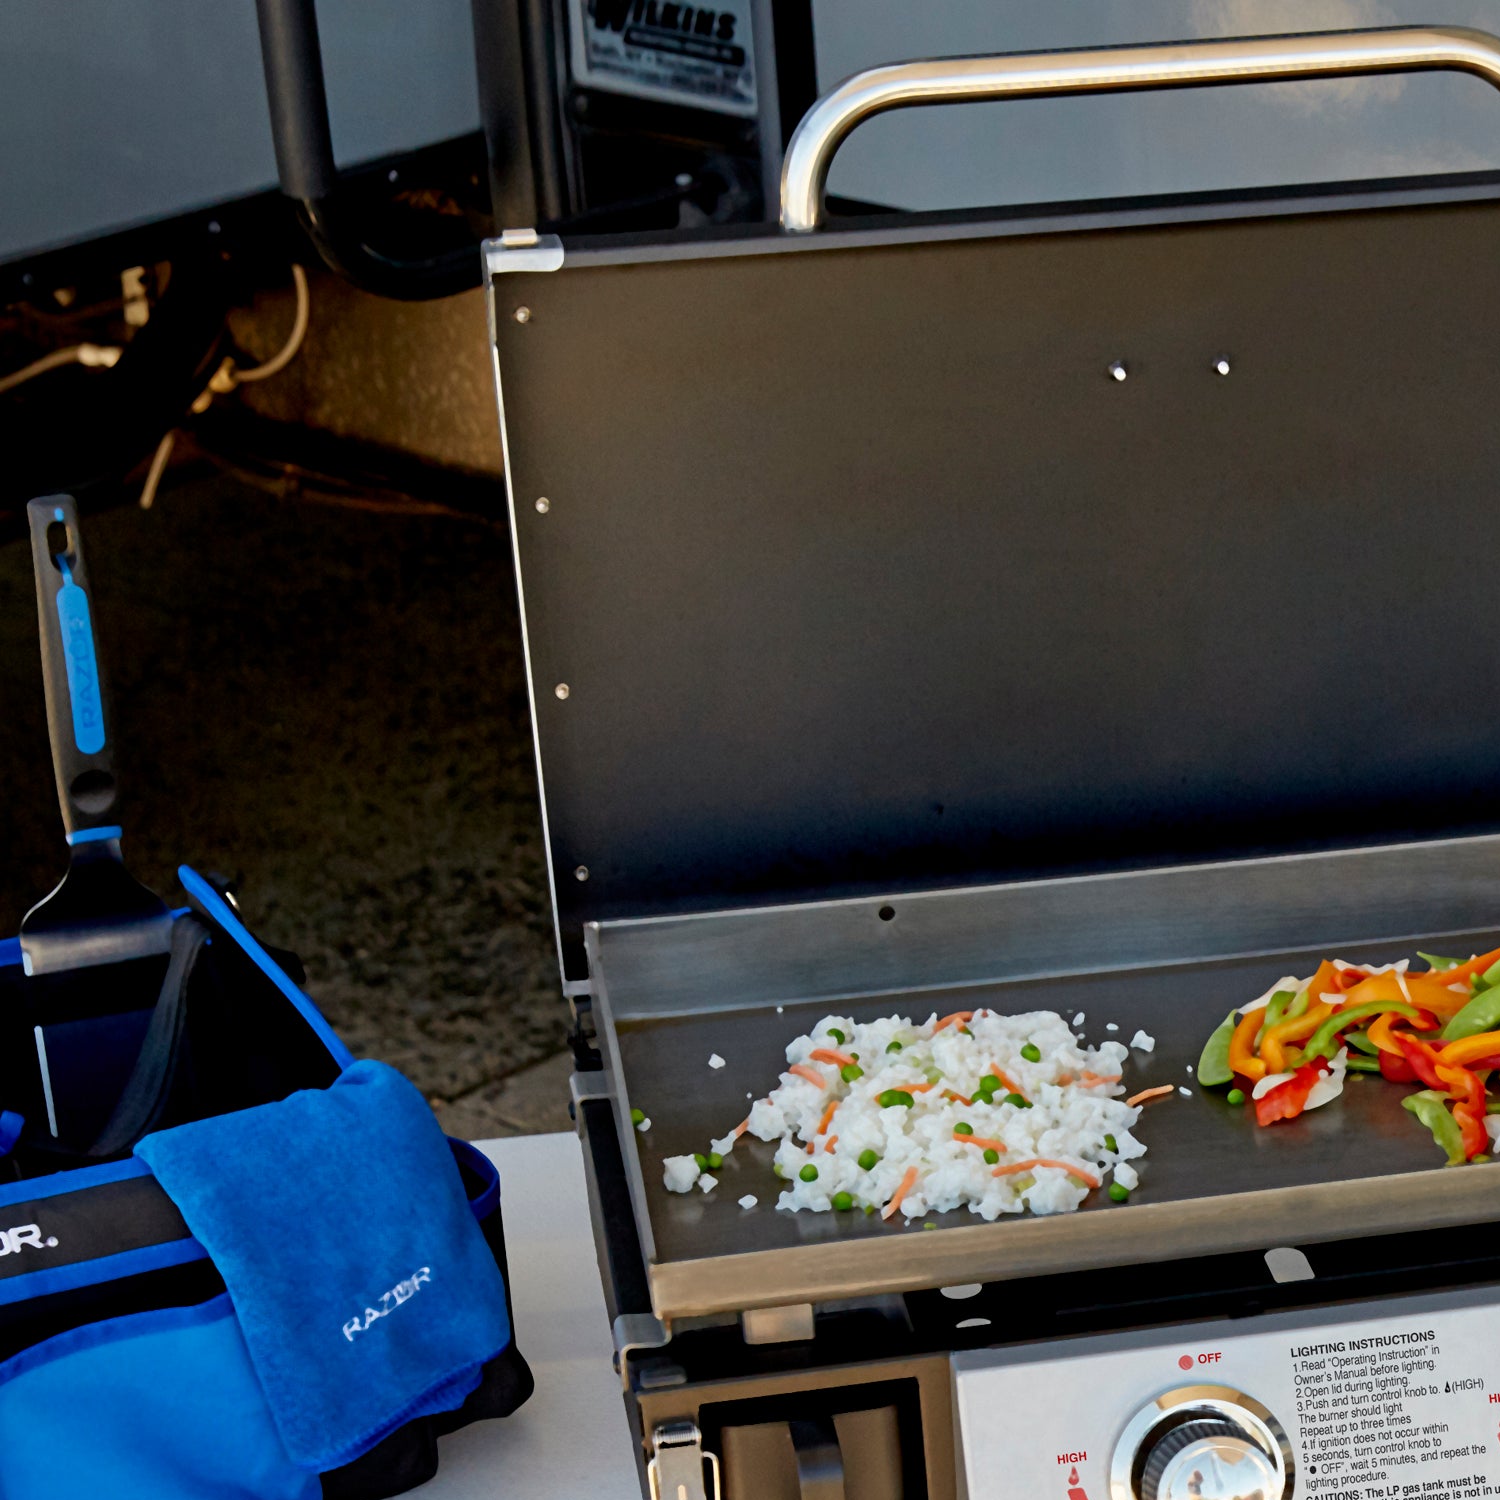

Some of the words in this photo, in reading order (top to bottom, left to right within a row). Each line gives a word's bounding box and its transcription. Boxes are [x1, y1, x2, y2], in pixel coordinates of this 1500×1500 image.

[342, 1266, 431, 1342] RAZOR
[1290, 1342, 1346, 1358] LIGHTING
[1349, 1330, 1436, 1351] INSTRUCTIONS
[1431, 1345, 1440, 1355] in
[1197, 1352, 1222, 1364] OFF
[1294, 1372, 1332, 1386] Owner's
[1334, 1366, 1368, 1380] Manual
[1370, 1363, 1399, 1376] before
[1401, 1360, 1437, 1374] lighting.
[1331, 1384, 1342, 1394] lid
[1345, 1380, 1373, 1392] during
[1375, 1376, 1411, 1390] lighting.
[1331, 1395, 1349, 1406] and
[1351, 1394, 1369, 1405] turn
[1371, 1388, 1402, 1403] control
[1404, 1385, 1427, 1398] knob
[1298, 1413, 1316, 1424] The
[1318, 1411, 1348, 1422] burner
[1351, 1405, 1381, 1418] should
[1383, 1402, 1403, 1416] light
[1300, 1426, 1334, 1438] Repeat
[1336, 1424, 1347, 1435] up
[1349, 1422, 1359, 1432] to
[1360, 1419, 1384, 1430] three
[1386, 1415, 1412, 1427] times
[1318, 1435, 1351, 1451] ignition
[1353, 1433, 1376, 1445] does
[1378, 1430, 1393, 1441] not
[1395, 1427, 1420, 1439] occur
[1422, 1423, 1449, 1435] within
[1057, 1450, 1087, 1465] HIGH
[1303, 1453, 1309, 1463] 5
[1311, 1449, 1352, 1463] seconds,
[1354, 1447, 1373, 1457] turn
[1375, 1441, 1406, 1455] control
[1408, 1437, 1431, 1450] knob
[1433, 1437, 1442, 1447] to
[1350, 1459, 1369, 1470] wait
[1371, 1458, 1378, 1468] 5
[1380, 1454, 1418, 1467] minutes,
[1420, 1450, 1438, 1462] and
[1440, 1446, 1469, 1460] repeat
[1471, 1444, 1487, 1455] the
[1305, 1477, 1338, 1491] lighting
[1341, 1471, 1389, 1487] procedure.
[1365, 1488, 1384, 1499] The
[1386, 1485, 1400, 1497] LP
[1402, 1484, 1420, 1496] gas
[1422, 1479, 1444, 1492] tank
[1446, 1476, 1471, 1488] must
[1474, 1474, 1486, 1485] be
[1453, 1489, 1462, 1500] is
[1464, 1488, 1480, 1498] not
[1483, 1486, 1493, 1496] in
